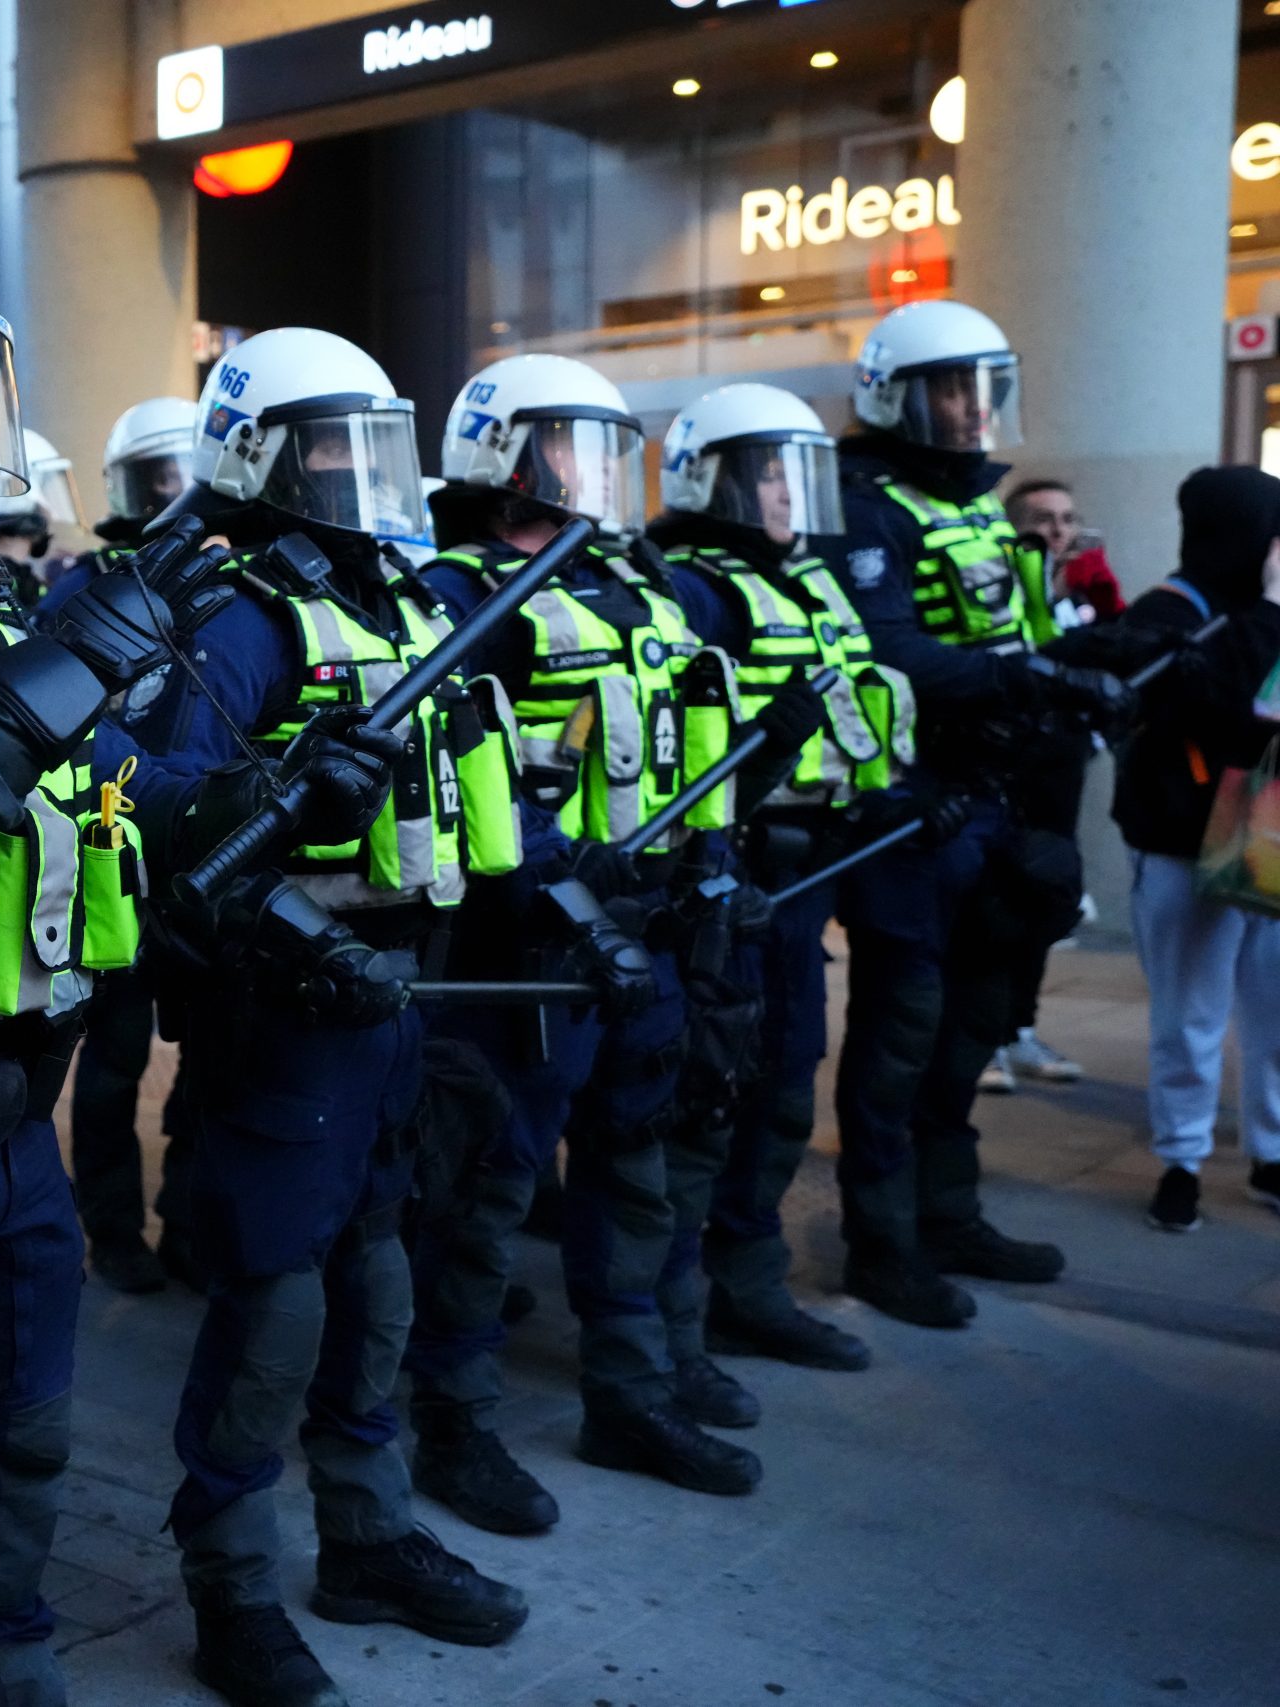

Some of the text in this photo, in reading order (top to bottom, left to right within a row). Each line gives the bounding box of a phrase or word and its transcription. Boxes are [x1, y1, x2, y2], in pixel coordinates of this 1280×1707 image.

[363, 14, 492, 74] Rideau
[655, 707, 676, 736] A
[438, 748, 456, 781] A
[655, 735, 677, 764] 12
[440, 781, 460, 814] 12
